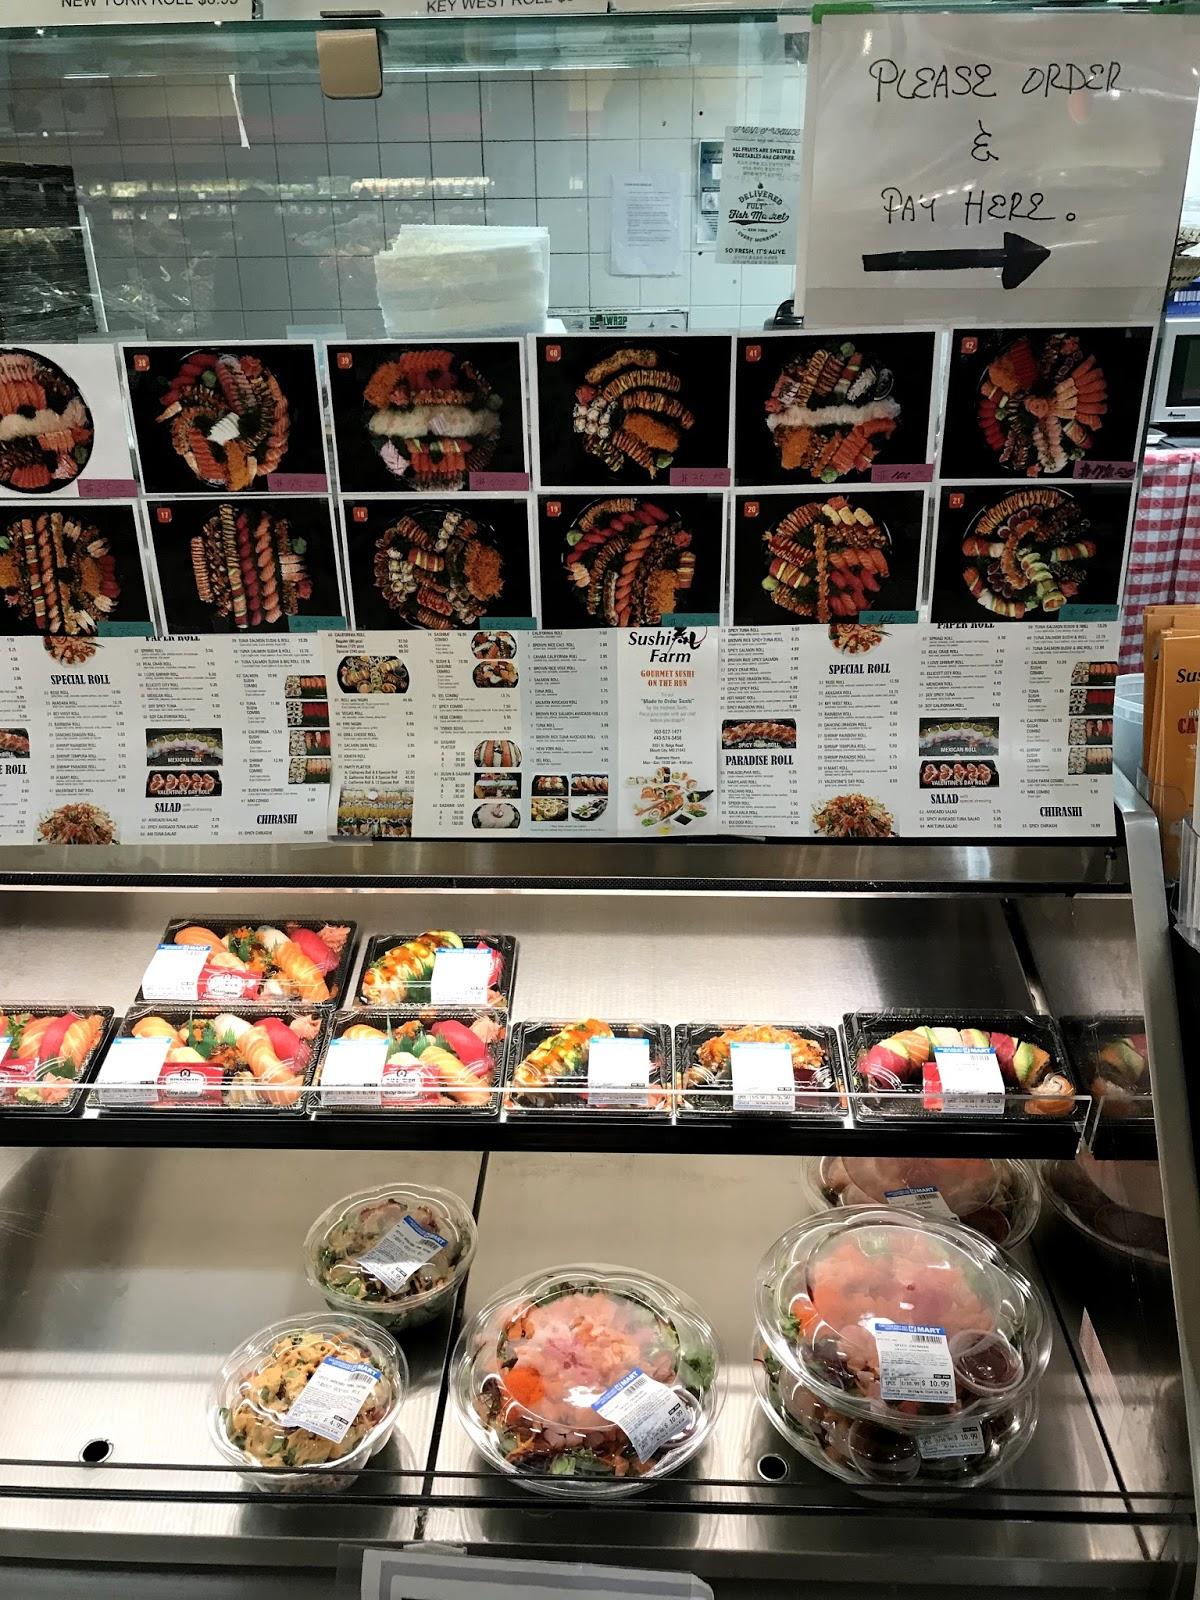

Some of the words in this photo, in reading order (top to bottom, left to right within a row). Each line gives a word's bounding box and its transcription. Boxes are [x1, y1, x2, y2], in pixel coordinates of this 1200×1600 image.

[428, 0, 459, 13] KEY
[869, 59, 996, 102] PLEASE
[1022, 61, 1128, 98] ORDER
[971, 119, 999, 161] &
[738, 190, 783, 206] DELIVERED
[881, 187, 936, 224] PAY
[728, 209, 749, 219] Fish
[628, 630, 672, 646] Sushi
[650, 649, 691, 663] Farm
[640, 670, 673, 678] GOURMET
[675, 670, 695, 678] SUSHI
[828, 664, 864, 674] SPECIAL
[867, 664, 891, 673] ROLL
[50, 674, 86, 685] SPECIAL
[88, 674, 111, 685] ROLL
[648, 679, 658, 687] ON
[659, 679, 673, 687] THE
[674, 679, 687, 687] RUN
[726, 755, 768, 766] PARADISE
[771, 755, 794, 765] ROLL
[5, 765, 28, 774] ROLL
[931, 794, 959, 804] SALAD
[155, 803, 181, 812] SALAD
[1040, 806, 1083, 817] CHIRASHI
[257, 814, 298, 824] CHIRASHI
[357, 1364, 378, 1376] MART
[620, 1370, 639, 1388] MART
